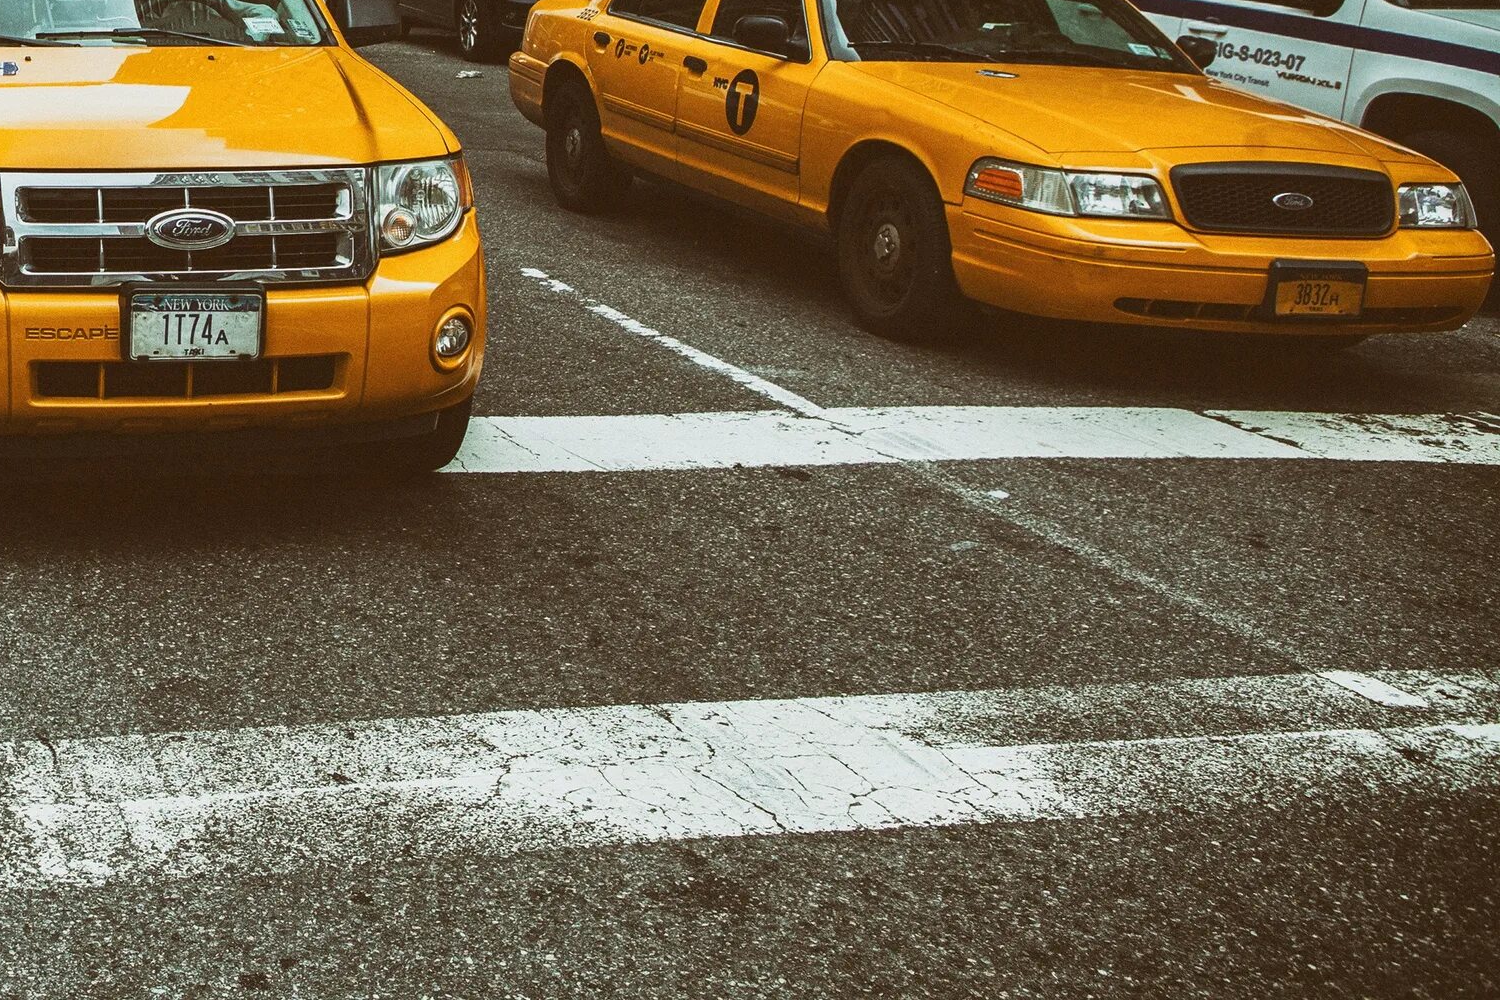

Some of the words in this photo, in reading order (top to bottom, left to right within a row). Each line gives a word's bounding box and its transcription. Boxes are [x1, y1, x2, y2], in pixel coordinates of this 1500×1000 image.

[1214, 42, 1306, 72] IG-S-023-07
[1219, 70, 1233, 80] York
[1234, 73, 1246, 83] City
[1247, 76, 1270, 87] Transit
[172, 219, 212, 237] Ford
[164, 298, 193, 310] NEW
[196, 298, 230, 311] YORK
[25, 327, 119, 341] ESCAPE
[184, 348, 205, 356] TAXI
